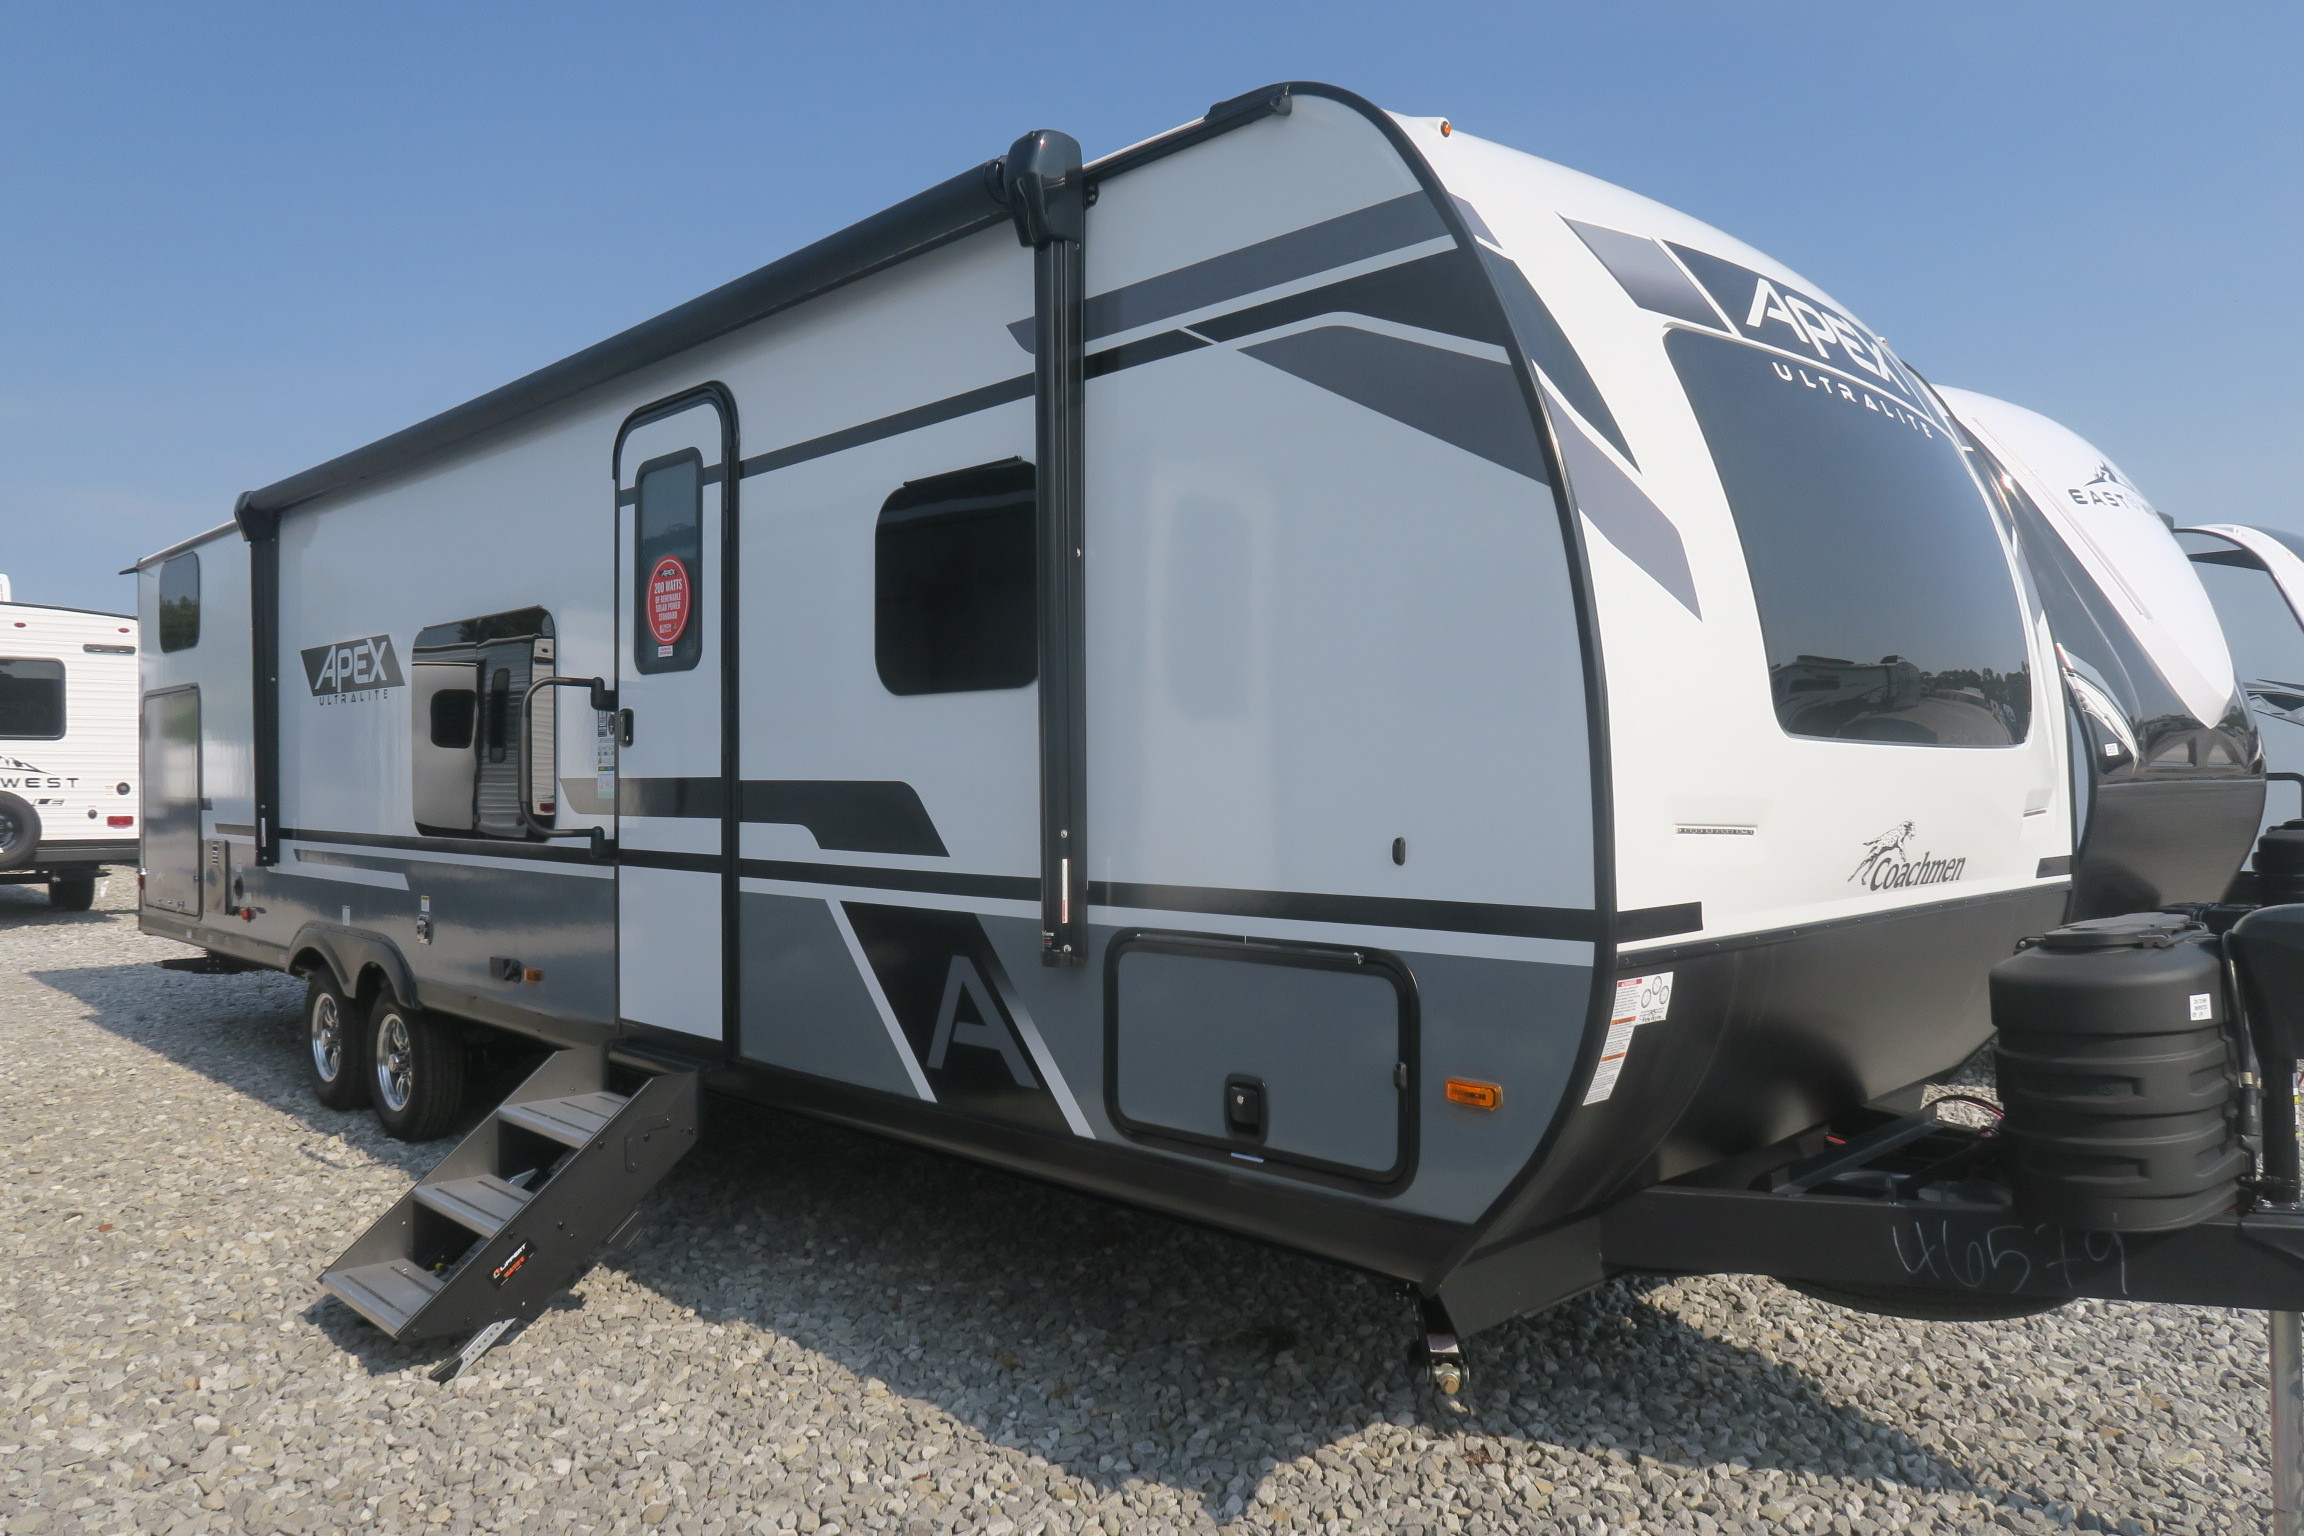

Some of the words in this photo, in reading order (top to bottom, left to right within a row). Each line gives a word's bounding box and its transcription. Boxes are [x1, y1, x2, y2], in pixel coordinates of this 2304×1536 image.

[1746, 278, 1910, 396] APEX
[1772, 361, 1932, 439] ULTRALITE
[665, 578, 683, 592] WATTS
[315, 638, 388, 693] APEX
[319, 689, 388, 706] ULTRALITE
[0, 777, 79, 788] WEST
[1870, 851, 1966, 892] Coachmen
[927, 954, 1040, 1090] A
